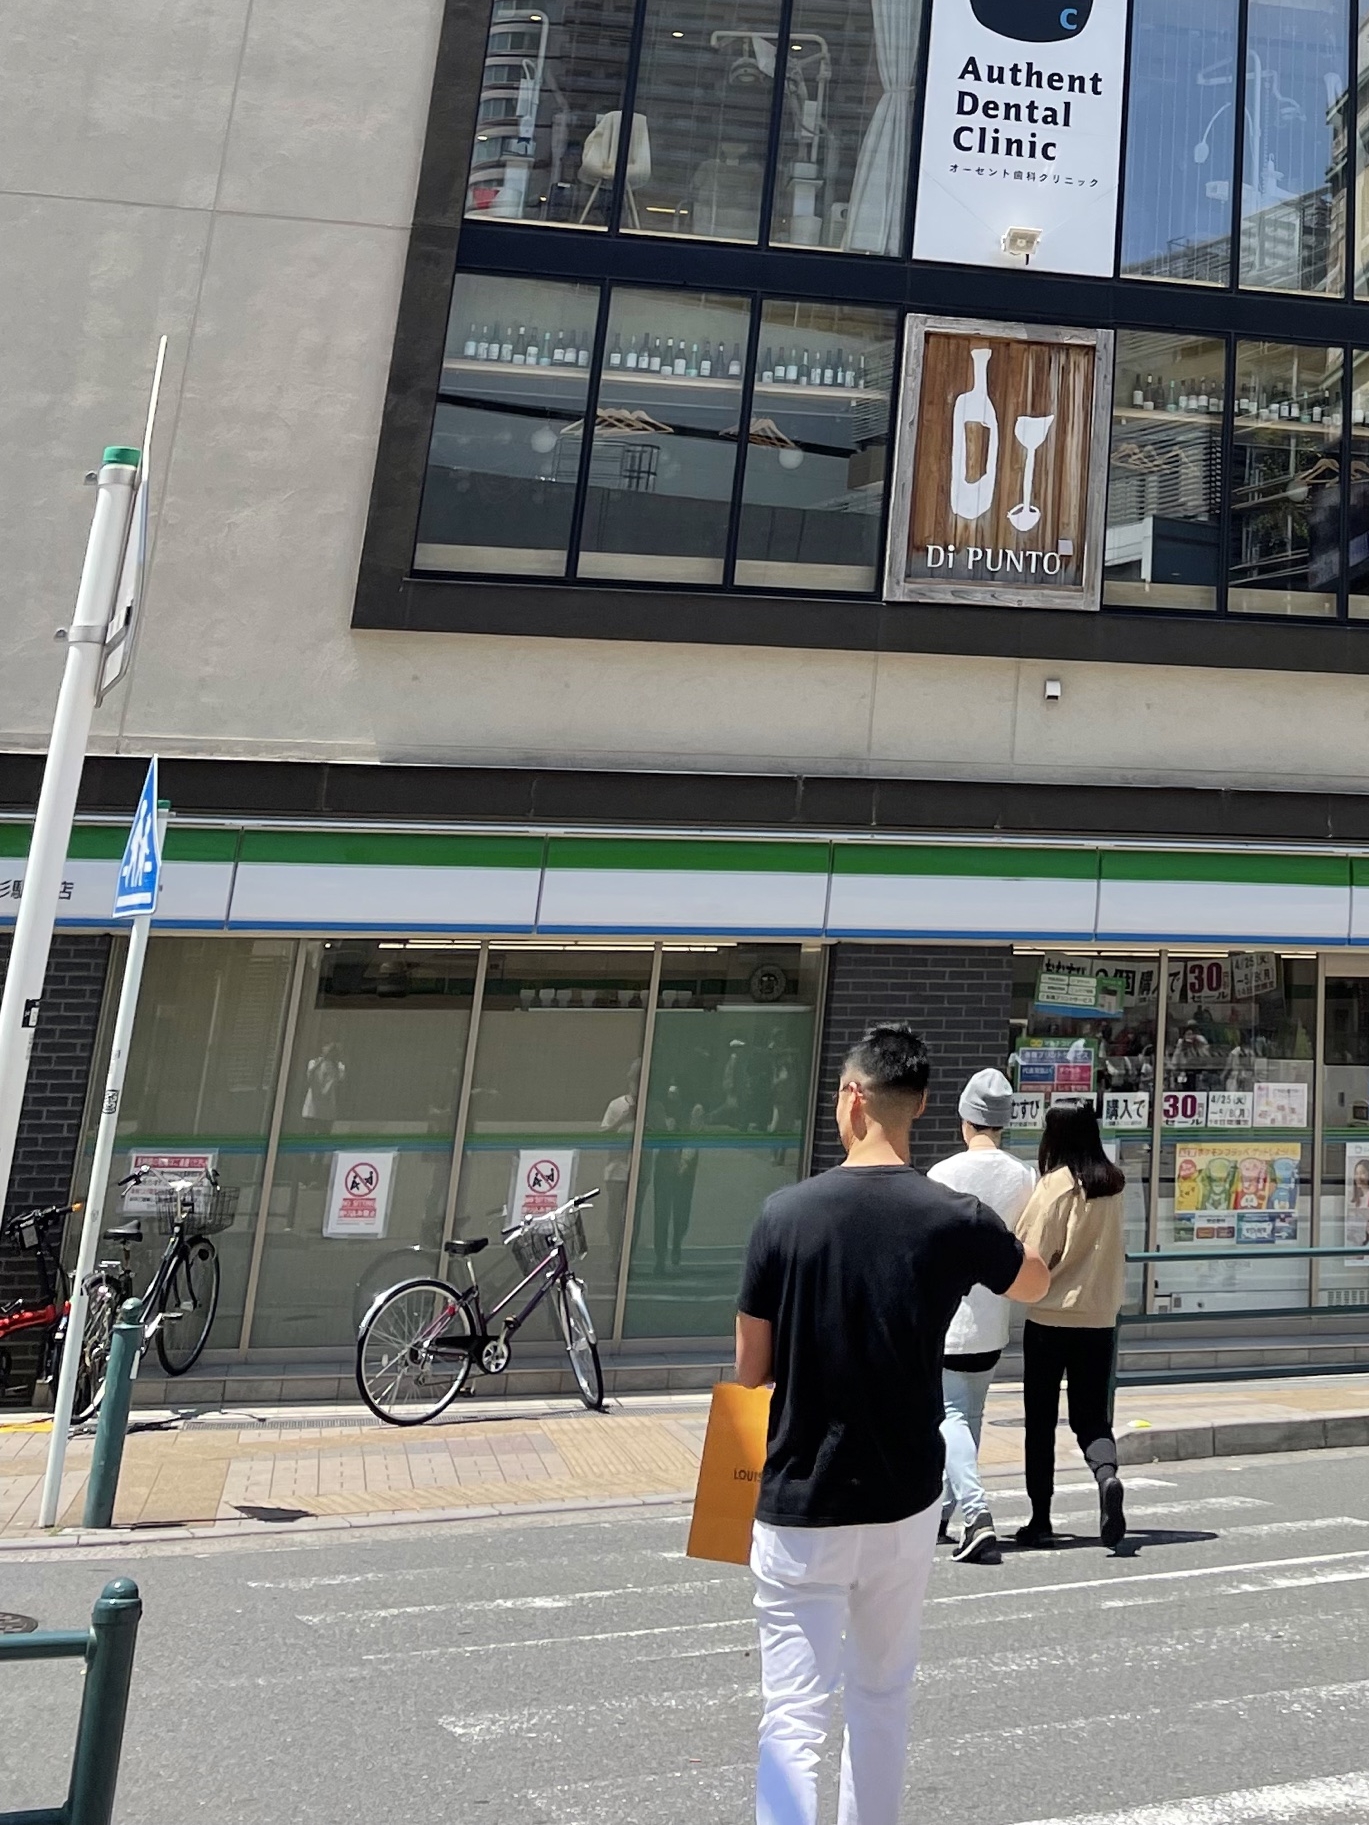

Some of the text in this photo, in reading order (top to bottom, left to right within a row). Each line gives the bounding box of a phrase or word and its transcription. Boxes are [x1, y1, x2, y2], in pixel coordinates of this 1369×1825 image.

[1059, 8, 1078, 30] C
[958, 55, 1103, 96] Authent
[955, 90, 1072, 128] Dental
[952, 126, 1057, 161] Clinic
[949, 163, 1099, 188] オーセント歯科クリニック
[926, 544, 1061, 575] Di PUNTO
[1189, 961, 1223, 994] 30
[1190, 991, 1228, 1003] セール
[1106, 1098, 1146, 1120] 購入で
[1163, 1094, 1197, 1119] 30
